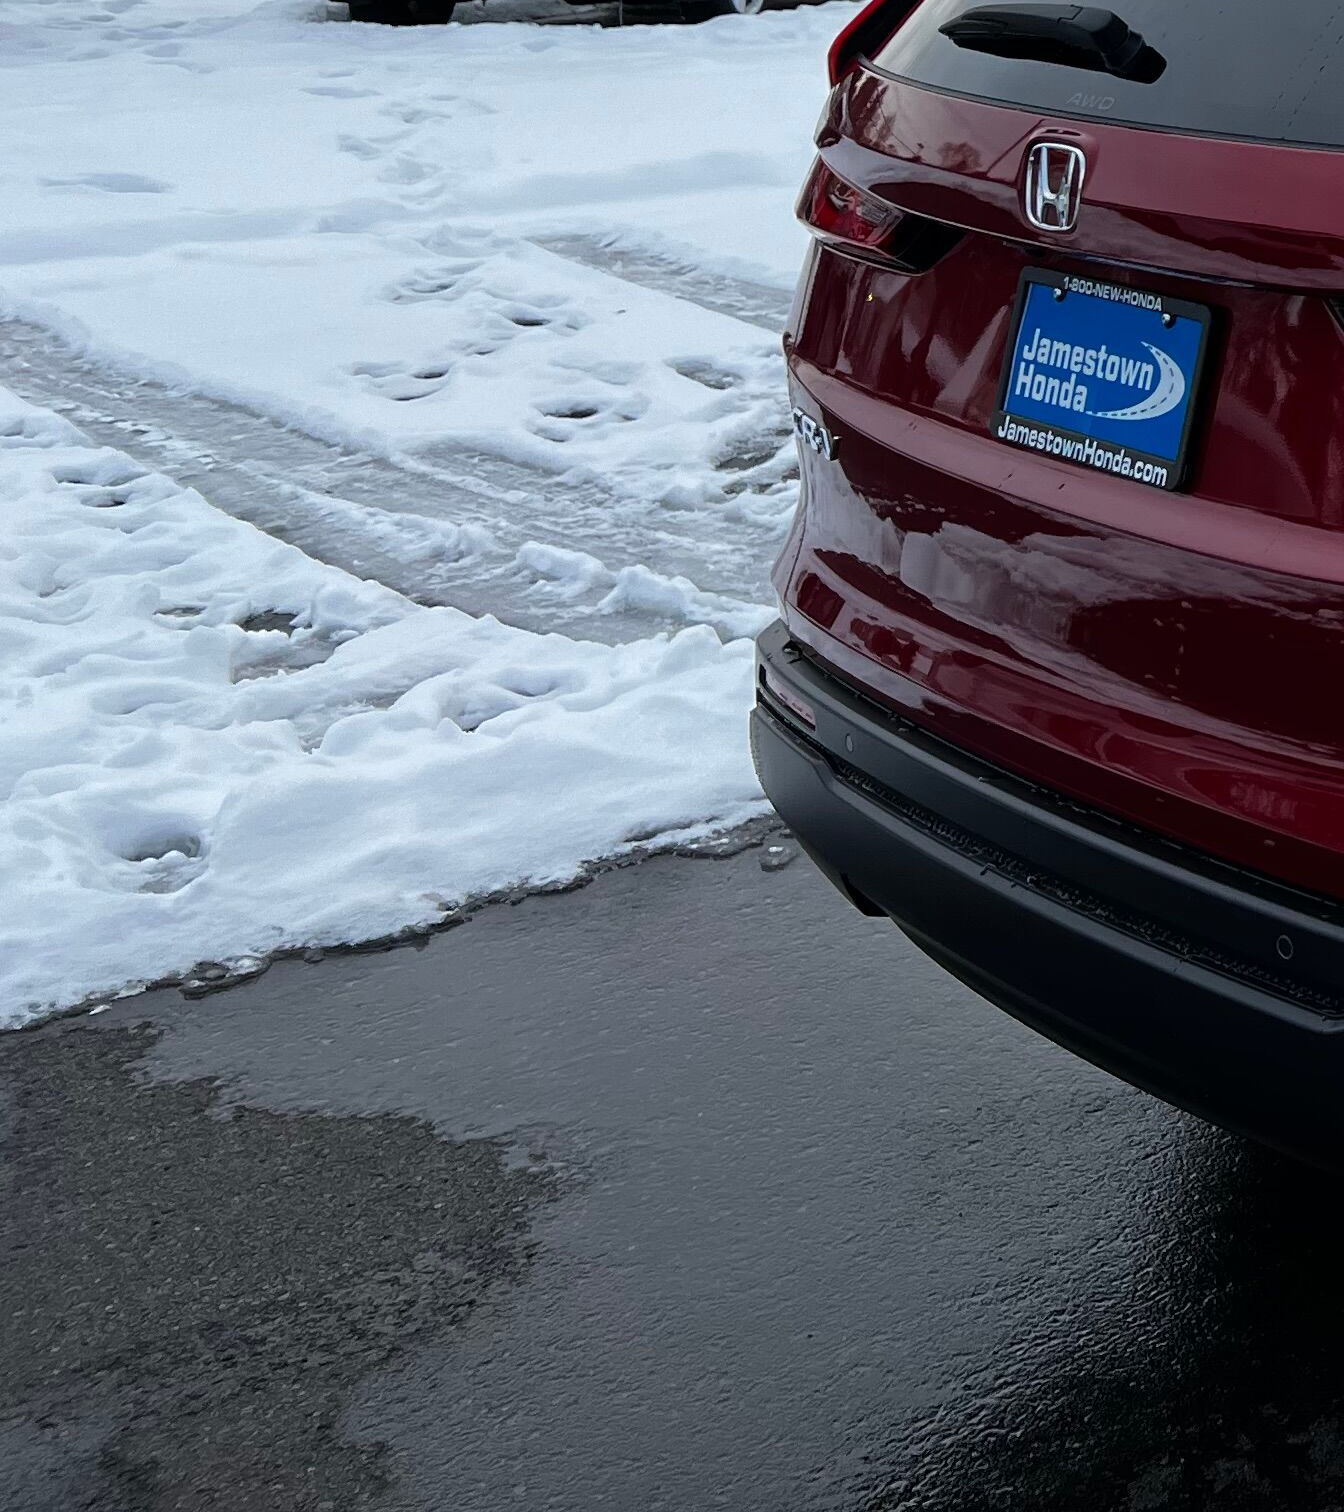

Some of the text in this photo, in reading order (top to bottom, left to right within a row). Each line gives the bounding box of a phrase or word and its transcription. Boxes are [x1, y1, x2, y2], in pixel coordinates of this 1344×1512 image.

[1064, 92, 1115, 110] AWD
[1062, 276, 1162, 312] 1-800-NEW-HONDA
[1022, 328, 1155, 391] Jamestown
[1014, 361, 1088, 413] Honda
[997, 415, 1169, 488] JamestownHonda.com
